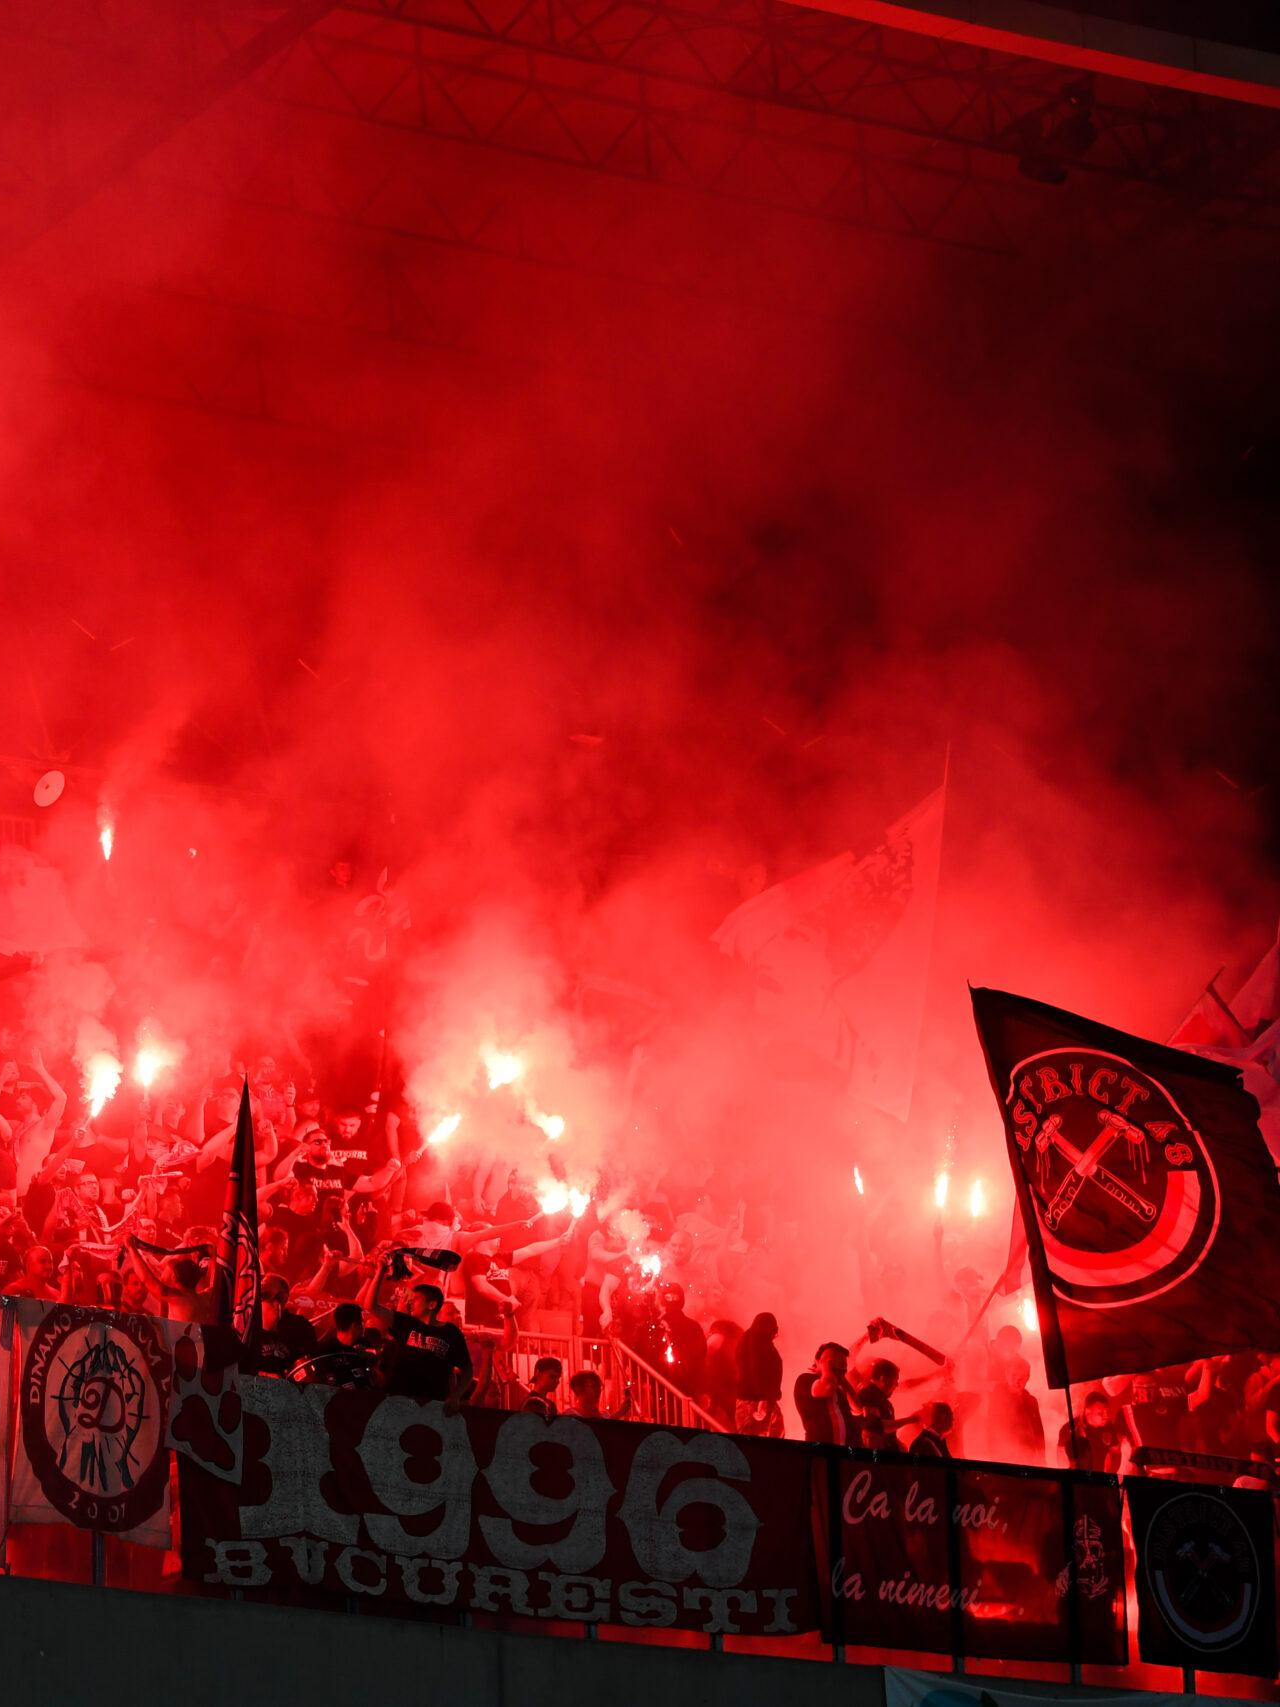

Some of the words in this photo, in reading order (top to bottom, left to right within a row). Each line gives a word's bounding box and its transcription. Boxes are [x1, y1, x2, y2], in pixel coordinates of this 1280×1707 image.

[1144, 1120, 1194, 1166] 48
[29, 1312, 72, 1405] DINAMO
[237, 1374, 765, 1589] 1996
[841, 1469, 890, 1526] Ca
[903, 1480, 939, 1526] la
[952, 1495, 1009, 1534] noi,
[831, 1556, 866, 1600] la
